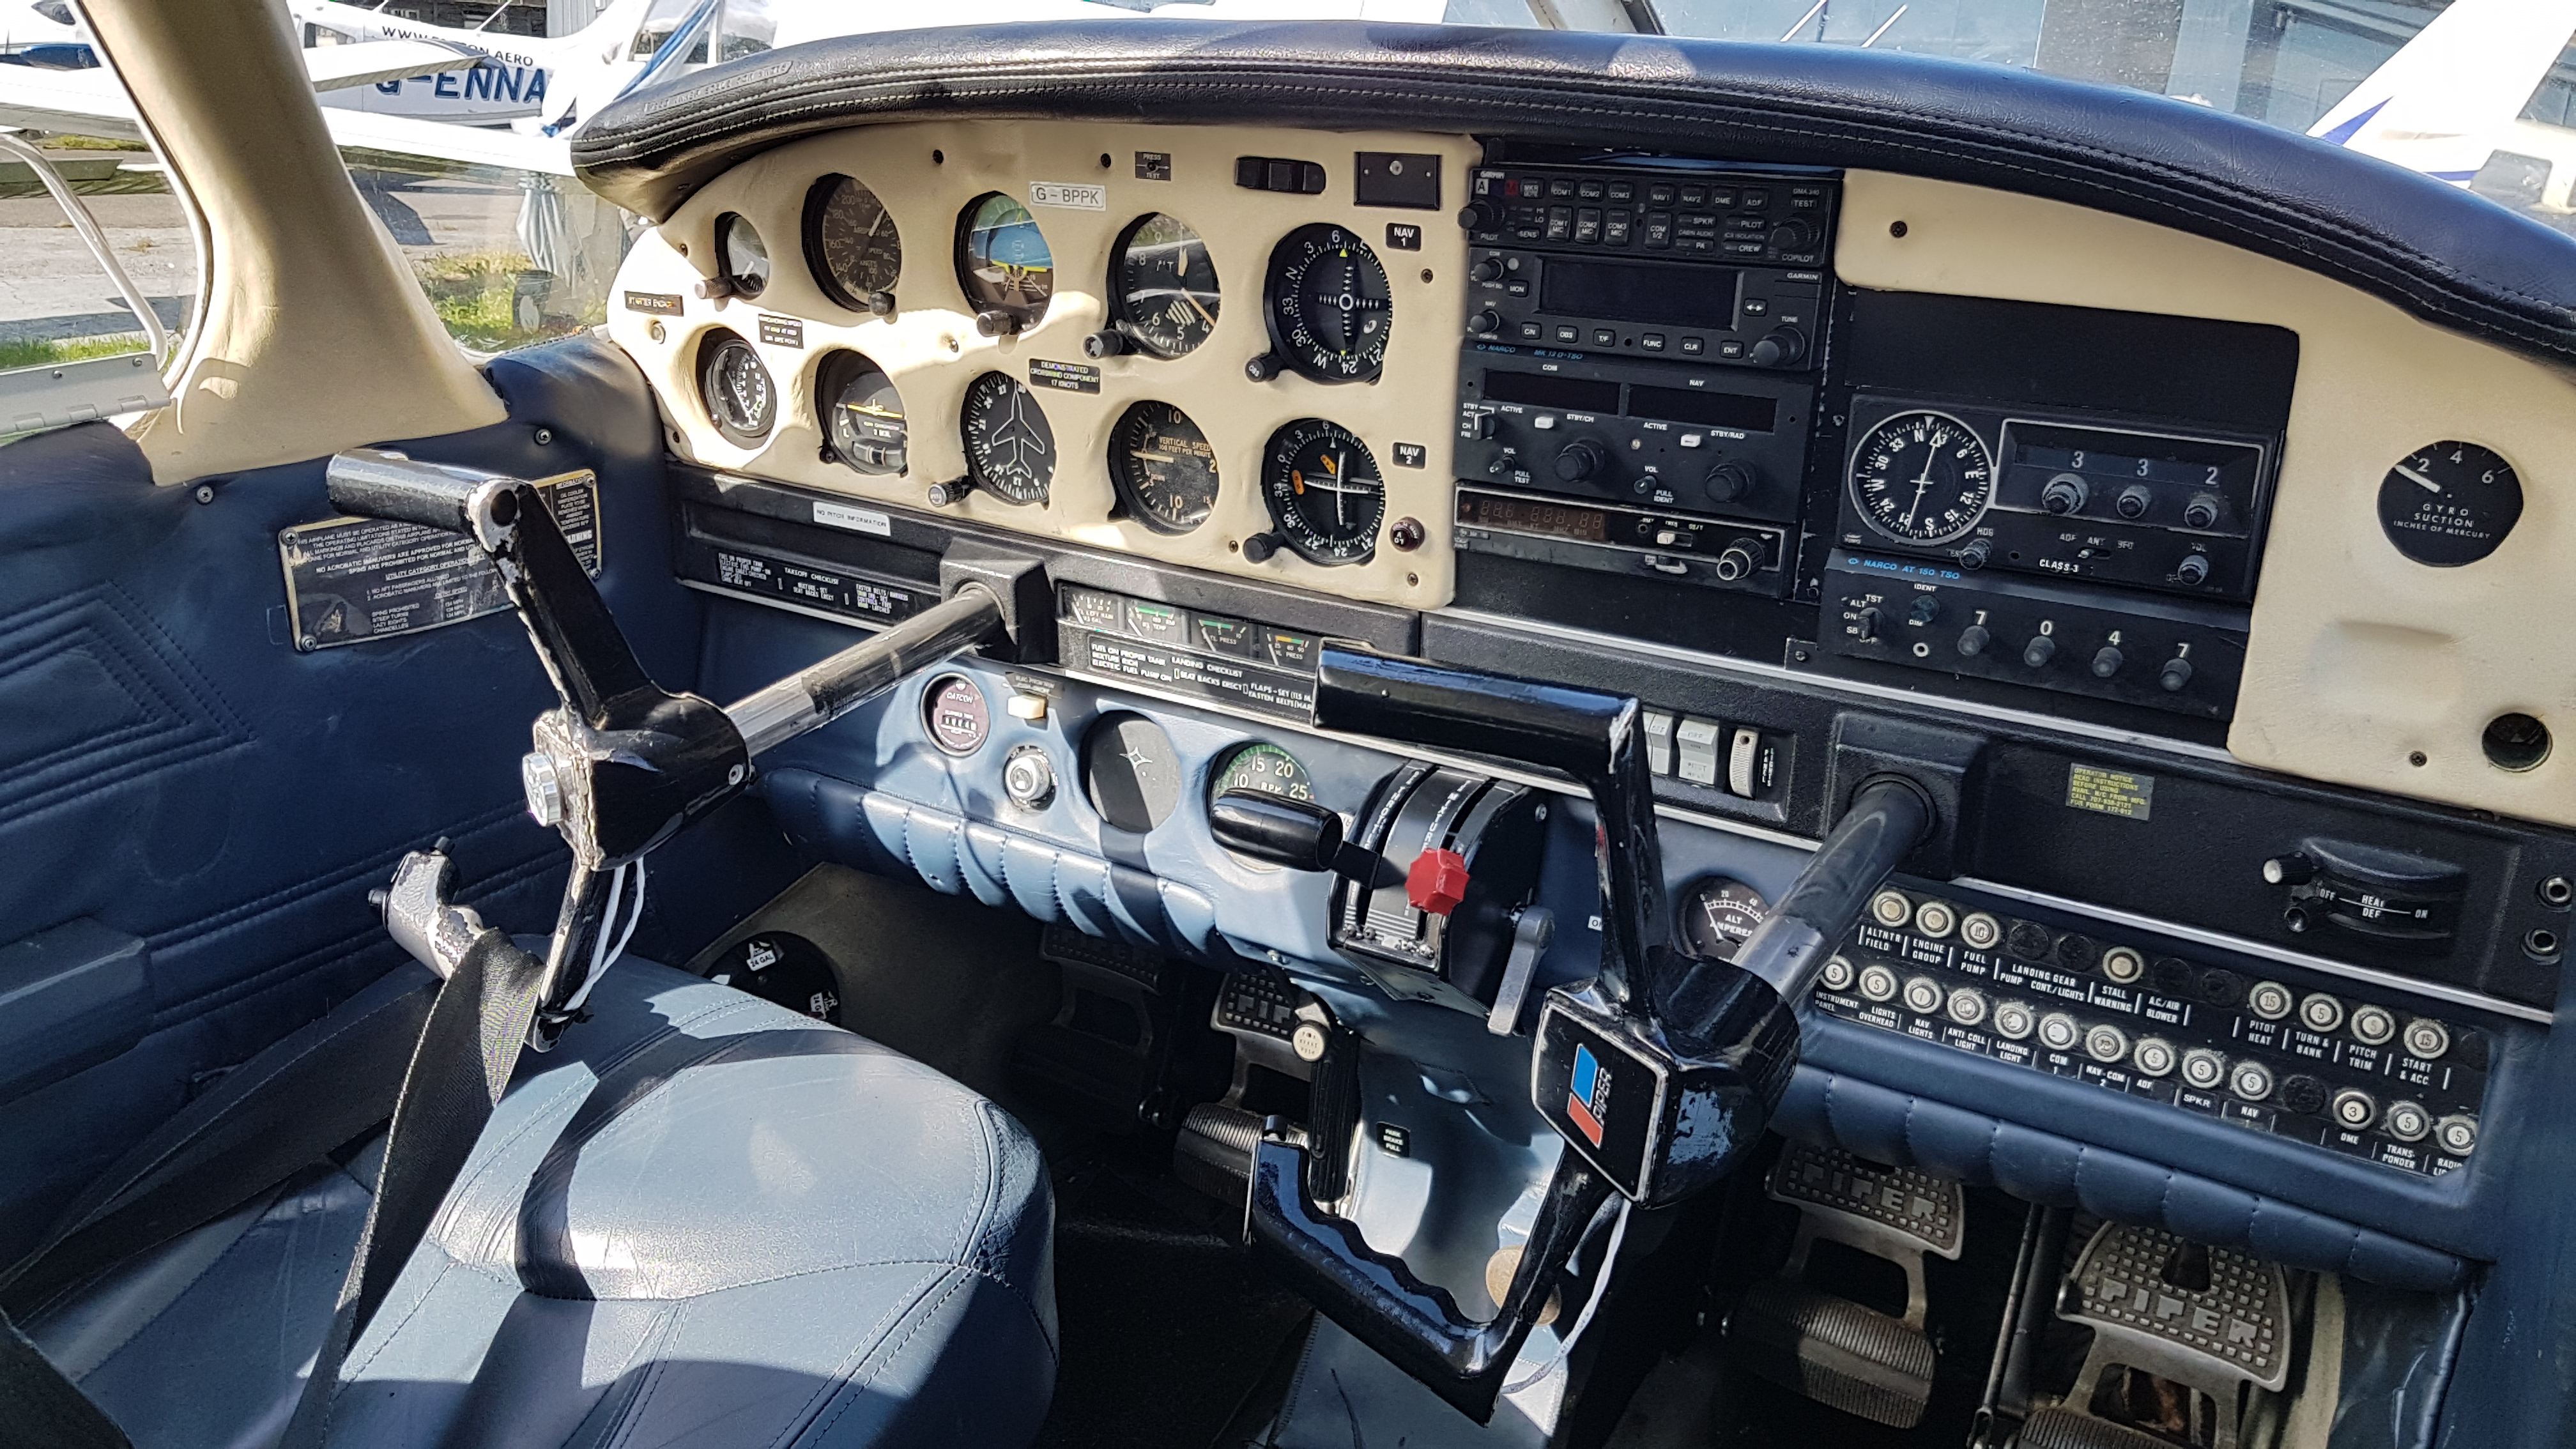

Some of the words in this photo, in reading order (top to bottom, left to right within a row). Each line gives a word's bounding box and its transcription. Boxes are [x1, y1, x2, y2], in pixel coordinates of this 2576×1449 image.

[495, 51, 533, 66] AERO
[1331, 230, 1340, 242] 6
[1394, 227, 1414, 238] NAV
[1304, 241, 1314, 254] 3
[1401, 238, 1406, 246] 1
[1282, 298, 1294, 315] 33
[1152, 314, 1160, 326] 6
[1292, 329, 1308, 347] 30
[1169, 410, 1181, 424] 10
[1567, 414, 1594, 422] STBY/CH
[1711, 430, 1744, 439] STBY/RAD
[1914, 429, 1924, 442] N
[1159, 436, 1188, 448] VERTICAL
[1192, 441, 1210, 451] SPEED
[1889, 438, 1905, 452] 33
[1400, 447, 1419, 457] NAV
[1956, 448, 1967, 458] 6
[2450, 450, 2463, 463] 4
[1406, 456, 1412, 464] 2
[1875, 455, 1888, 470] 30
[2071, 451, 2084, 468] 3
[2417, 458, 2430, 472] 2
[2136, 459, 2149, 477] 3
[2205, 467, 2218, 484] 2
[2482, 470, 2494, 484] 6
[1170, 494, 1183, 509] 10
[1959, 491, 1974, 505] 12
[1880, 498, 1894, 512] 24
[2423, 504, 2469, 516] GYRO
[1944, 509, 1959, 522] 15
[2414, 513, 2474, 527] SUCTION
[1925, 518, 1933, 530] S
[2394, 520, 2426, 530] INCHES
[2446, 528, 2490, 539] MERCURY
[408, 564, 438, 575] CATEGORY
[1864, 560, 1897, 570] NARCO
[1940, 571, 1960, 579] TSO
[2039, 559, 2078, 572] CLASS-3
[1866, 594, 1883, 603] TST
[1975, 611, 1986, 625] 7
[2108, 631, 2120, 645] 4
[2177, 643, 2189, 658] 7
[1172, 656, 1204, 670] LANDING
[1207, 664, 1243, 678] CHECKLIST
[1197, 675, 1220, 686] BACKS
[1250, 683, 1272, 694] FLAPS
[1248, 691, 1274, 702] FASTEN
[1252, 756, 1265, 772] 15
[1275, 761, 1293, 778] 20
[1234, 773, 1248, 788] 10
[2074, 768, 2107, 778] OPERATOR
[2110, 774, 2133, 783] NOTICE
[2073, 780, 2097, 790] BEFORE
[2094, 778, 2138, 791] INSTRUCTIONS
[1289, 783, 1307, 800] 25
[2319, 889, 2335, 901] OFF
[2361, 895, 2384, 907] HEAT
[1726, 914, 1742, 924] ALT
[2362, 908, 2382, 919] DEF
[2415, 909, 2428, 919] ON
[1867, 928, 1901, 942] ALTNTR
[1866, 939, 1890, 951] FIELD
[1913, 939, 1945, 953] ENGINE
[1912, 951, 1941, 964] GROUP
[1964, 951, 1986, 963] FUEL
[1961, 963, 1986, 975] PUMP
[2012, 963, 2050, 981] LANDING
[2053, 974, 2076, 986] GEAR
[2000, 973, 2023, 985] PUMP
[2102, 985, 2127, 999] STALL
[1815, 1000, 1836, 1012] PANEL
[1816, 992, 1859, 1009] INSTRUMENT
[2094, 996, 2131, 1013] WARNING
[2264, 995, 2276, 1007] 15
[1871, 1006, 1896, 1019] LIGHTS
[2146, 1009, 2177, 1023] BLOWER
[1859, 1012, 1894, 1027] OVERHEAD
[1915, 1019, 1929, 1029] NAV
[1909, 1026, 1933, 1039] LIGHTS
[2250, 1020, 2276, 1034] PITOT
[1948, 1028, 1965, 1039] ANTI
[1968, 1033, 1985, 1044] COLL
[2248, 1032, 2271, 1045] HEAT
[2295, 1031, 2320, 1045] TURN
[1955, 1039, 1976, 1050] LIGHT
[1997, 1041, 2028, 1055] LANDING
[2000, 1051, 2021, 1063] LIGHT
[2296, 1044, 2322, 1059] BANK
[2349, 1045, 2377, 1059] PITCH
[2050, 1054, 2067, 1066] COM
[2349, 1057, 2373, 1071] TRIM
[2402, 1058, 2431, 1071] START
[2136, 1079, 2153, 1089] ADF
[1593, 1066, 1613, 1125] PIPER
[2184, 1094, 2210, 1108] SPKR
[2241, 1107, 2258, 1118] NAV
[2349, 1107, 2357, 1117] 3
[1385, 1128, 1401, 1137] PARK
[2341, 1133, 2358, 1145] DME
[2387, 1144, 2415, 1158] TRANS-
[2382, 1154, 2415, 1169] PONDER
[2099, 1277, 2259, 1349] PIPER
